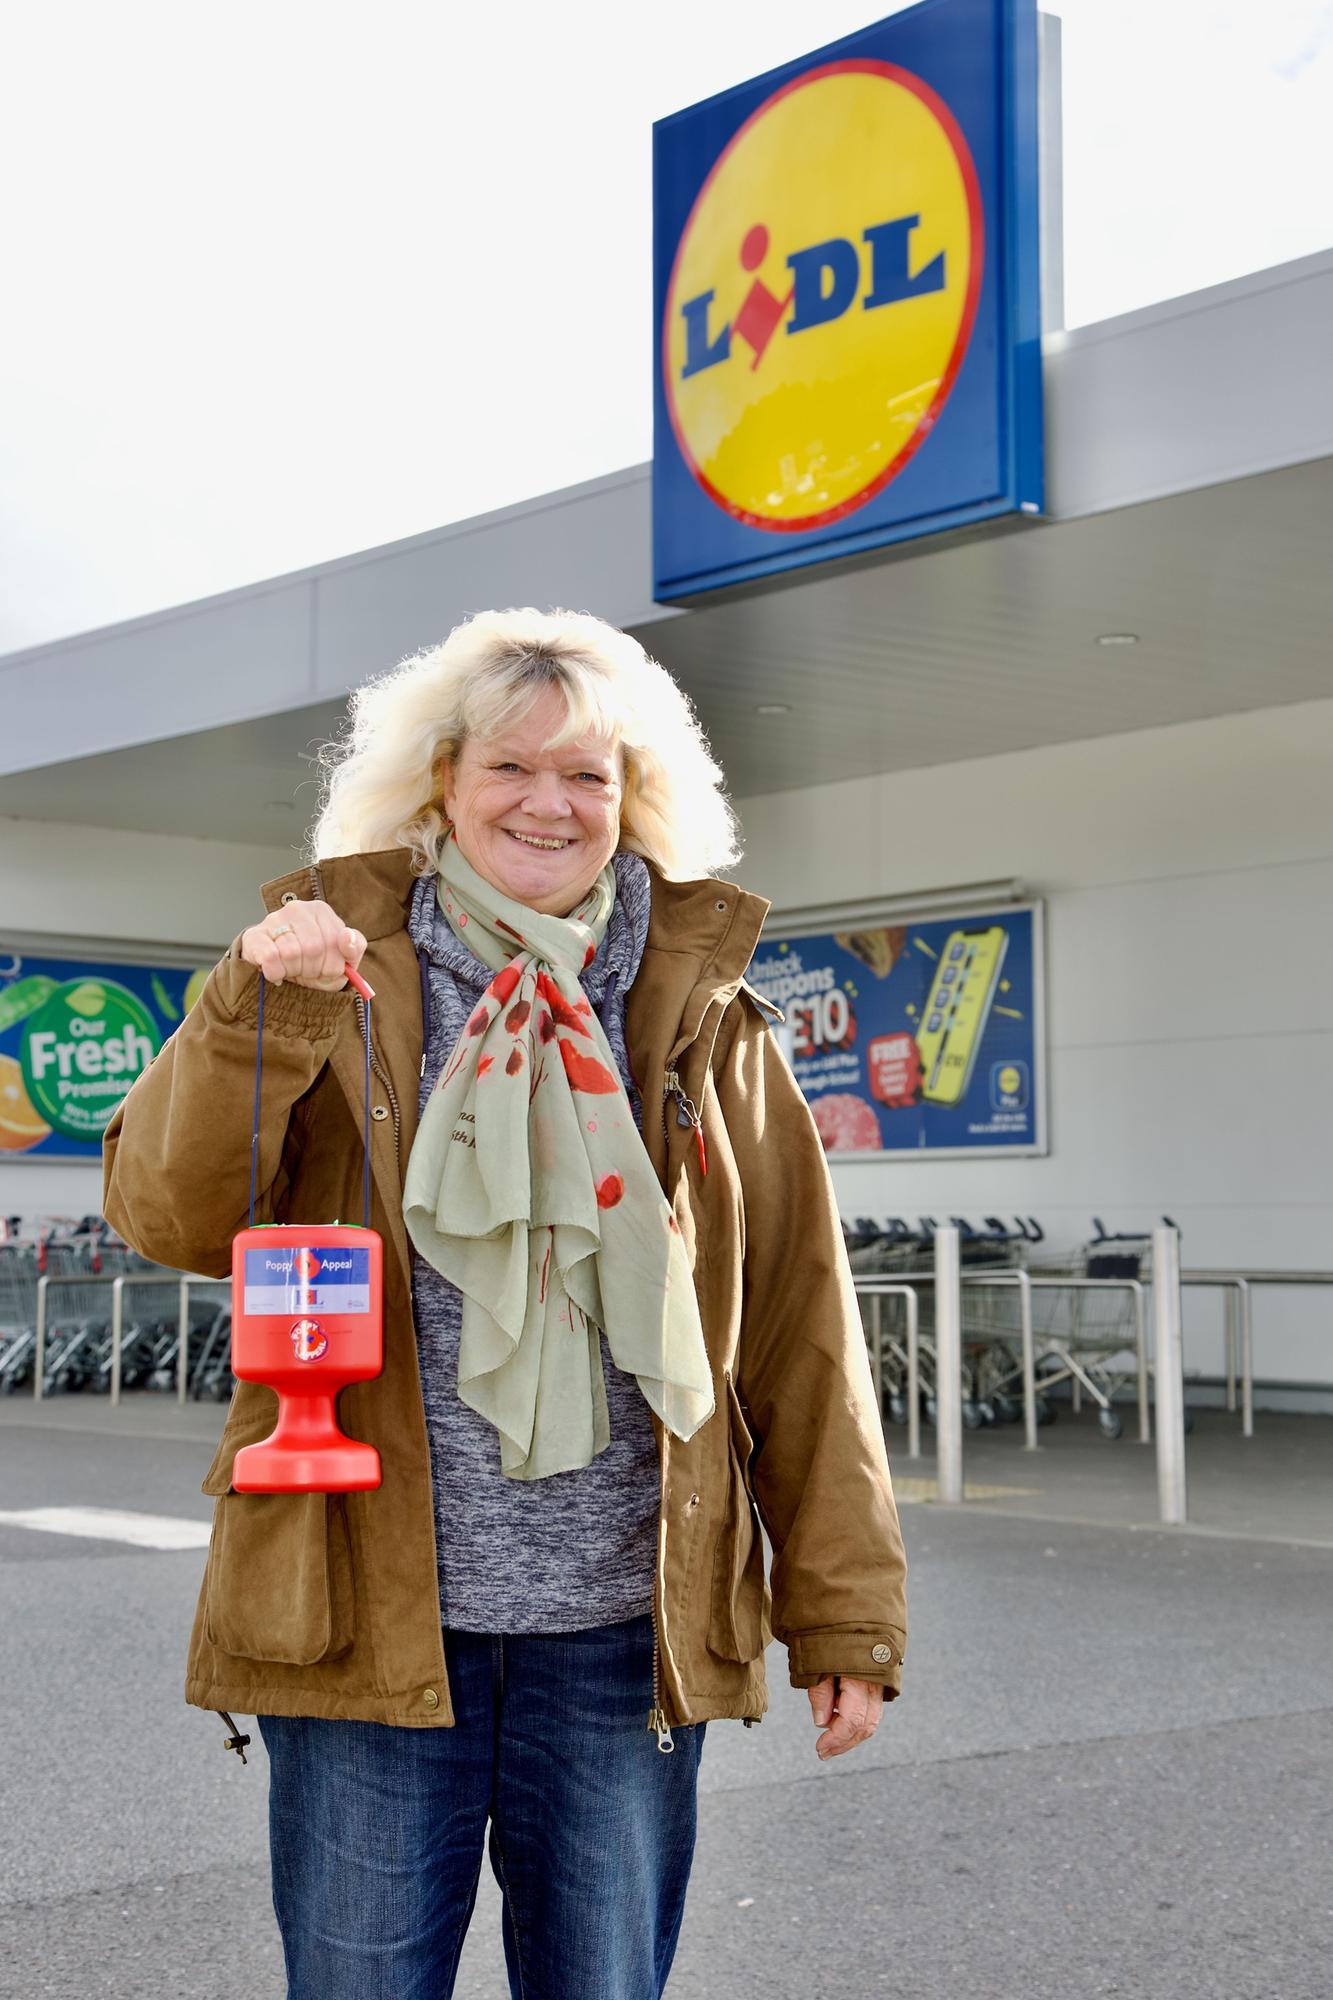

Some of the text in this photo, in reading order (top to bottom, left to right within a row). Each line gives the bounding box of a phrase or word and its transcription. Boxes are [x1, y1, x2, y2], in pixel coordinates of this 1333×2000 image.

[69, 1018, 106, 1037] Our
[786, 988, 849, 1049] £10
[30, 1024, 153, 1080] Fresh
[266, 1259, 353, 1272] Poppy Appeal
